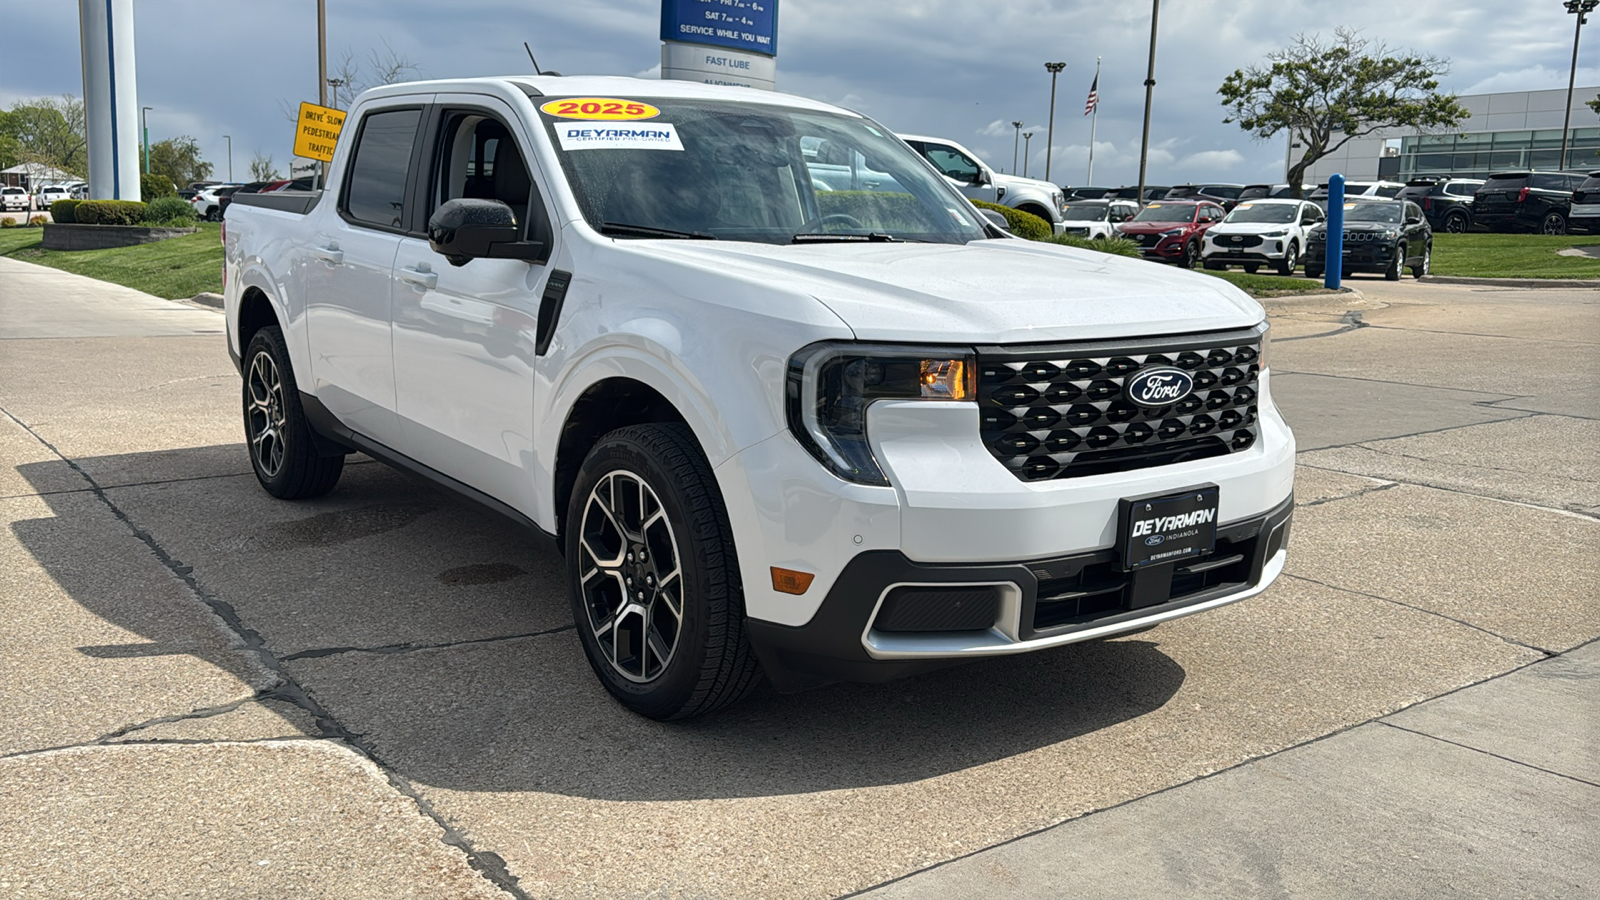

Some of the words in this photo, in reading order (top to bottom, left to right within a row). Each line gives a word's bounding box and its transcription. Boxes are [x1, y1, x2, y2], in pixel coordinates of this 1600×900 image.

[705, 10, 720, 20] SAT
[680, 24, 714, 36] SERVICE
[716, 28, 739, 40] WHILE
[741, 32, 755, 43] YOU
[756, 35, 771, 45] WAIT
[705, 55, 727, 66] FAST
[728, 58, 750, 70] LUBE
[557, 102, 646, 116] 2025
[305, 110, 324, 123] DRIVE
[326, 115, 343, 126] SLOW
[567, 129, 670, 138] DEYARMAN
[308, 142, 334, 156] TRAFFIC
[1142, 375, 1182, 399] Ford
[1131, 507, 1216, 538] DEYARMAN
[1166, 529, 1199, 541] INDIANOLA
